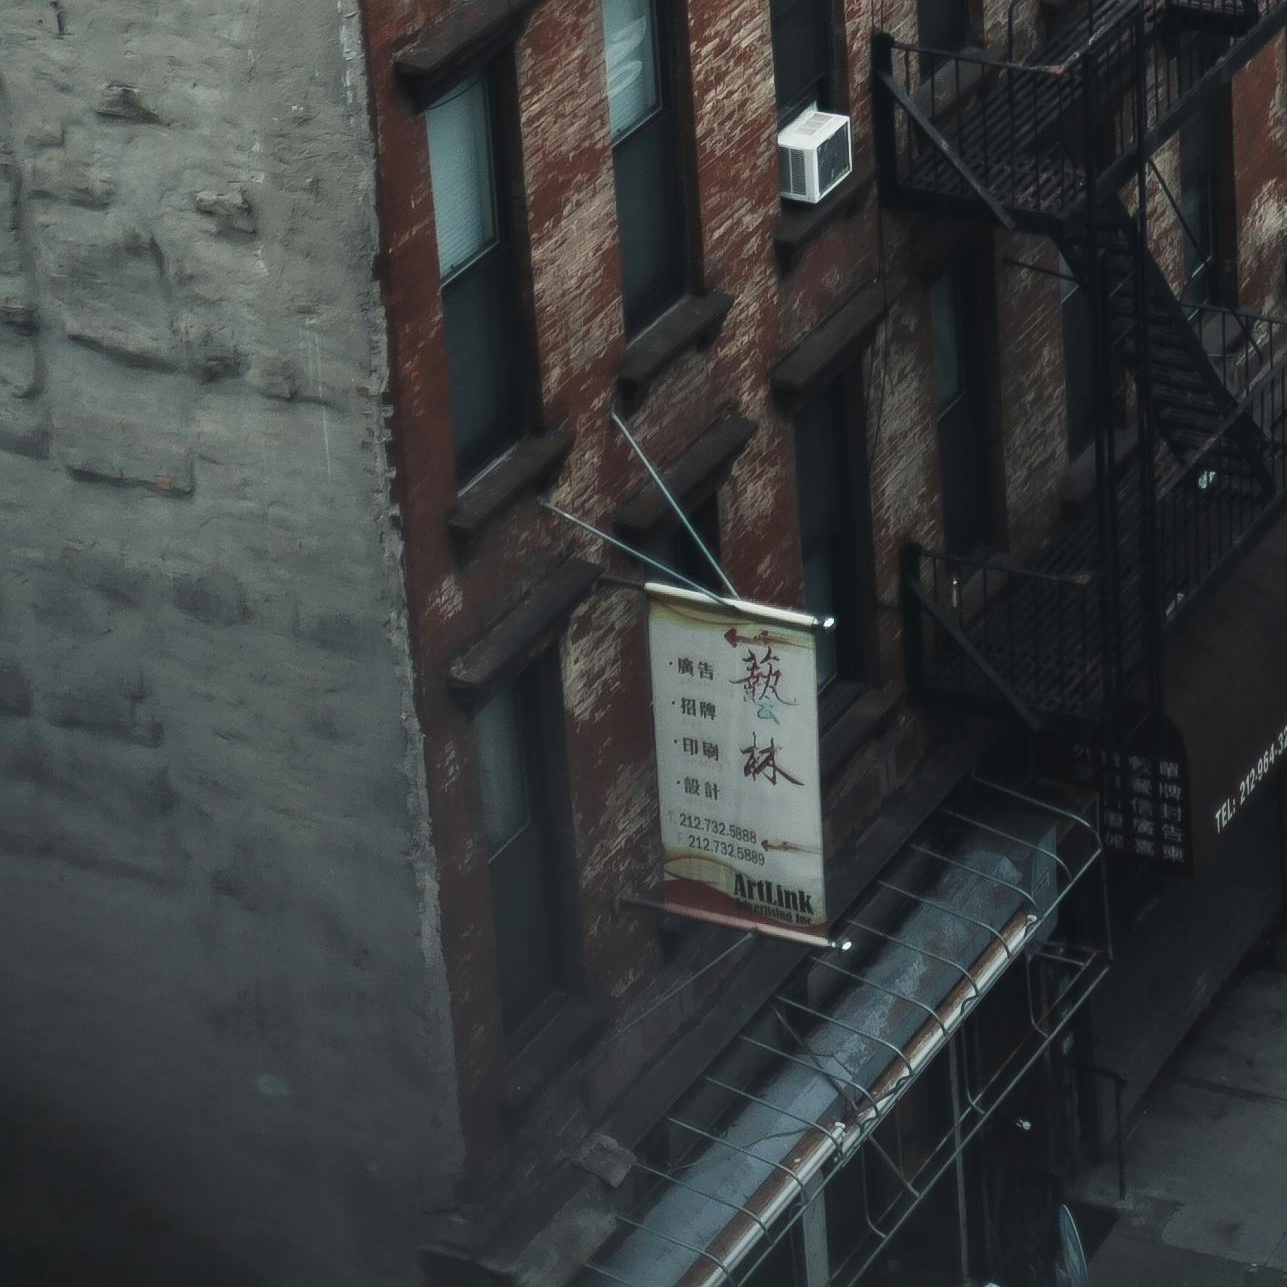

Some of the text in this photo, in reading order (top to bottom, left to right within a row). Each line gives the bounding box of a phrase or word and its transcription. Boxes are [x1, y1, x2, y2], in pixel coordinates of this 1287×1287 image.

[677, 657, 714, 681] 廣告
[681, 696, 717, 721] 招牌
[682, 736, 719, 761] 印刷
[683, 776, 720, 801] 設計
[679, 812, 757, 844] 212.732.5888
[1215, 797, 1236, 834] TEL:
[688, 834, 766, 866] 212.732.5889
[734, 873, 814, 915] ArtLink
